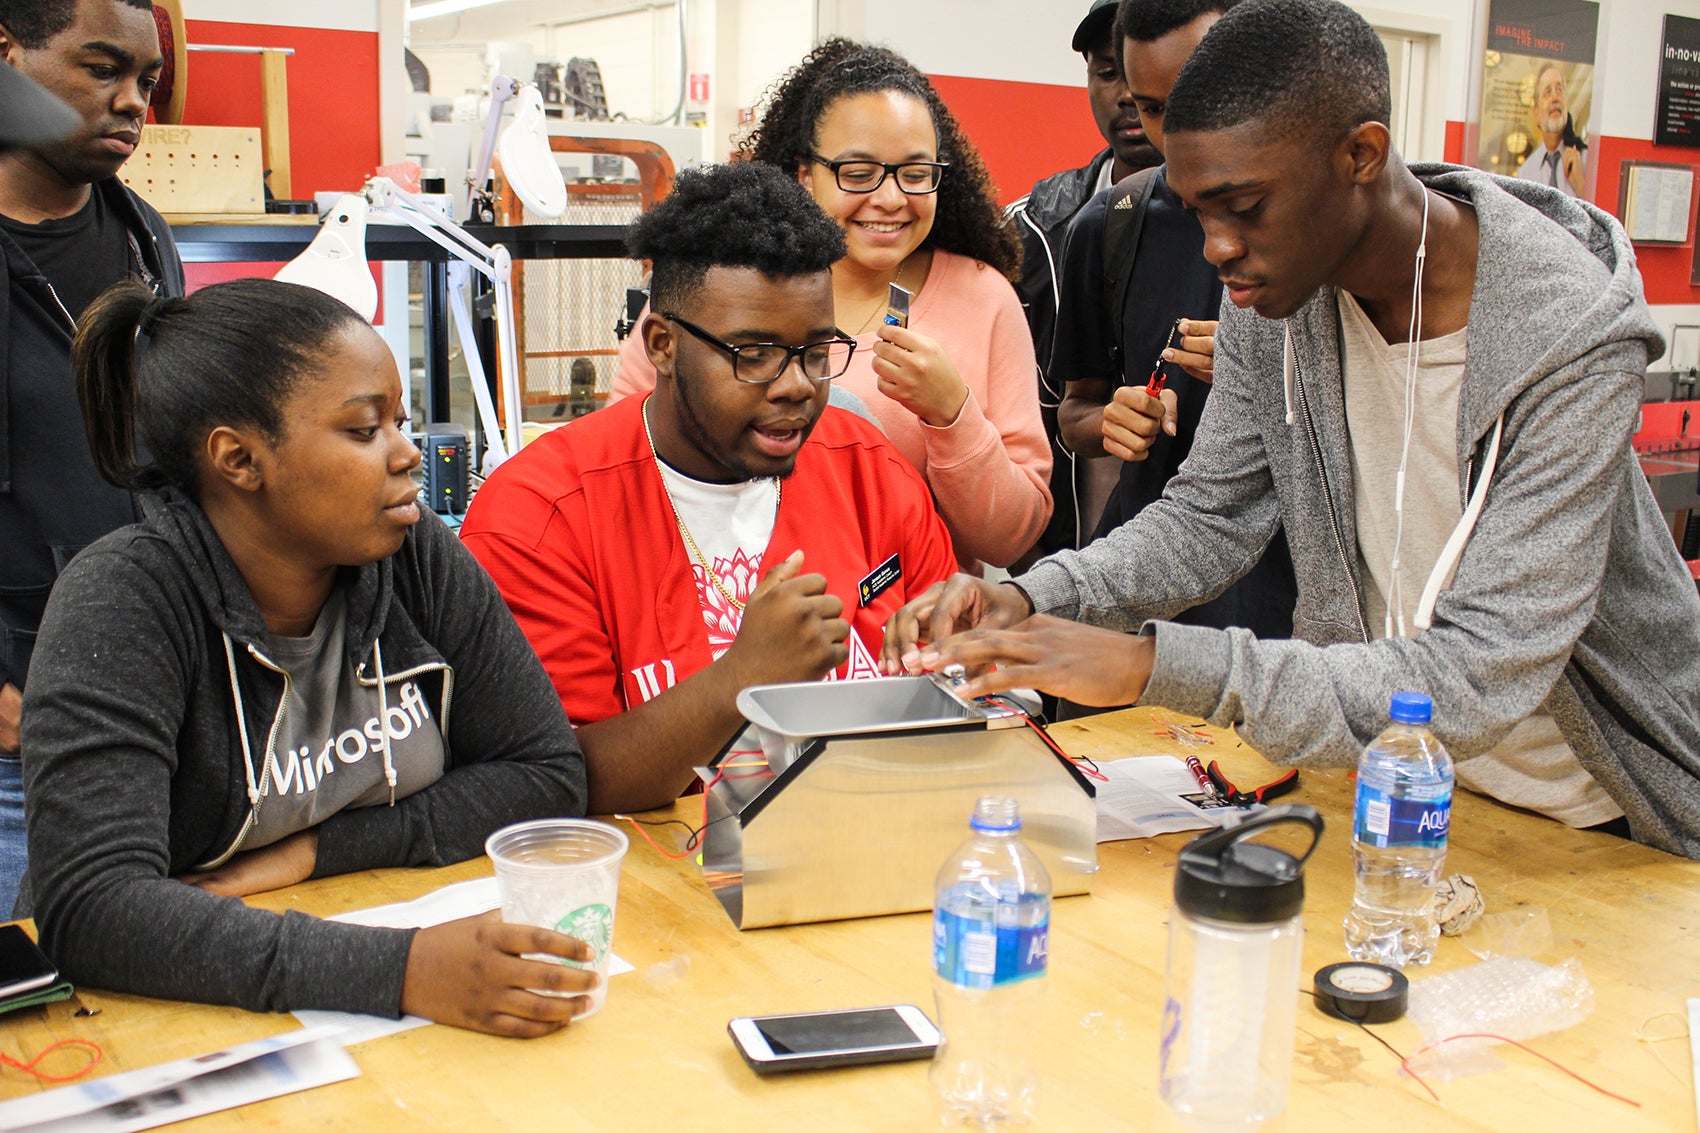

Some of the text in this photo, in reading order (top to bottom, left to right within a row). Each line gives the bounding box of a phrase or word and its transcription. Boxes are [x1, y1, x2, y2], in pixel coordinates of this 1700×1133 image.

[1495, 25, 1532, 38] IMAGINE
[1516, 37, 1565, 52] THE IMPACT
